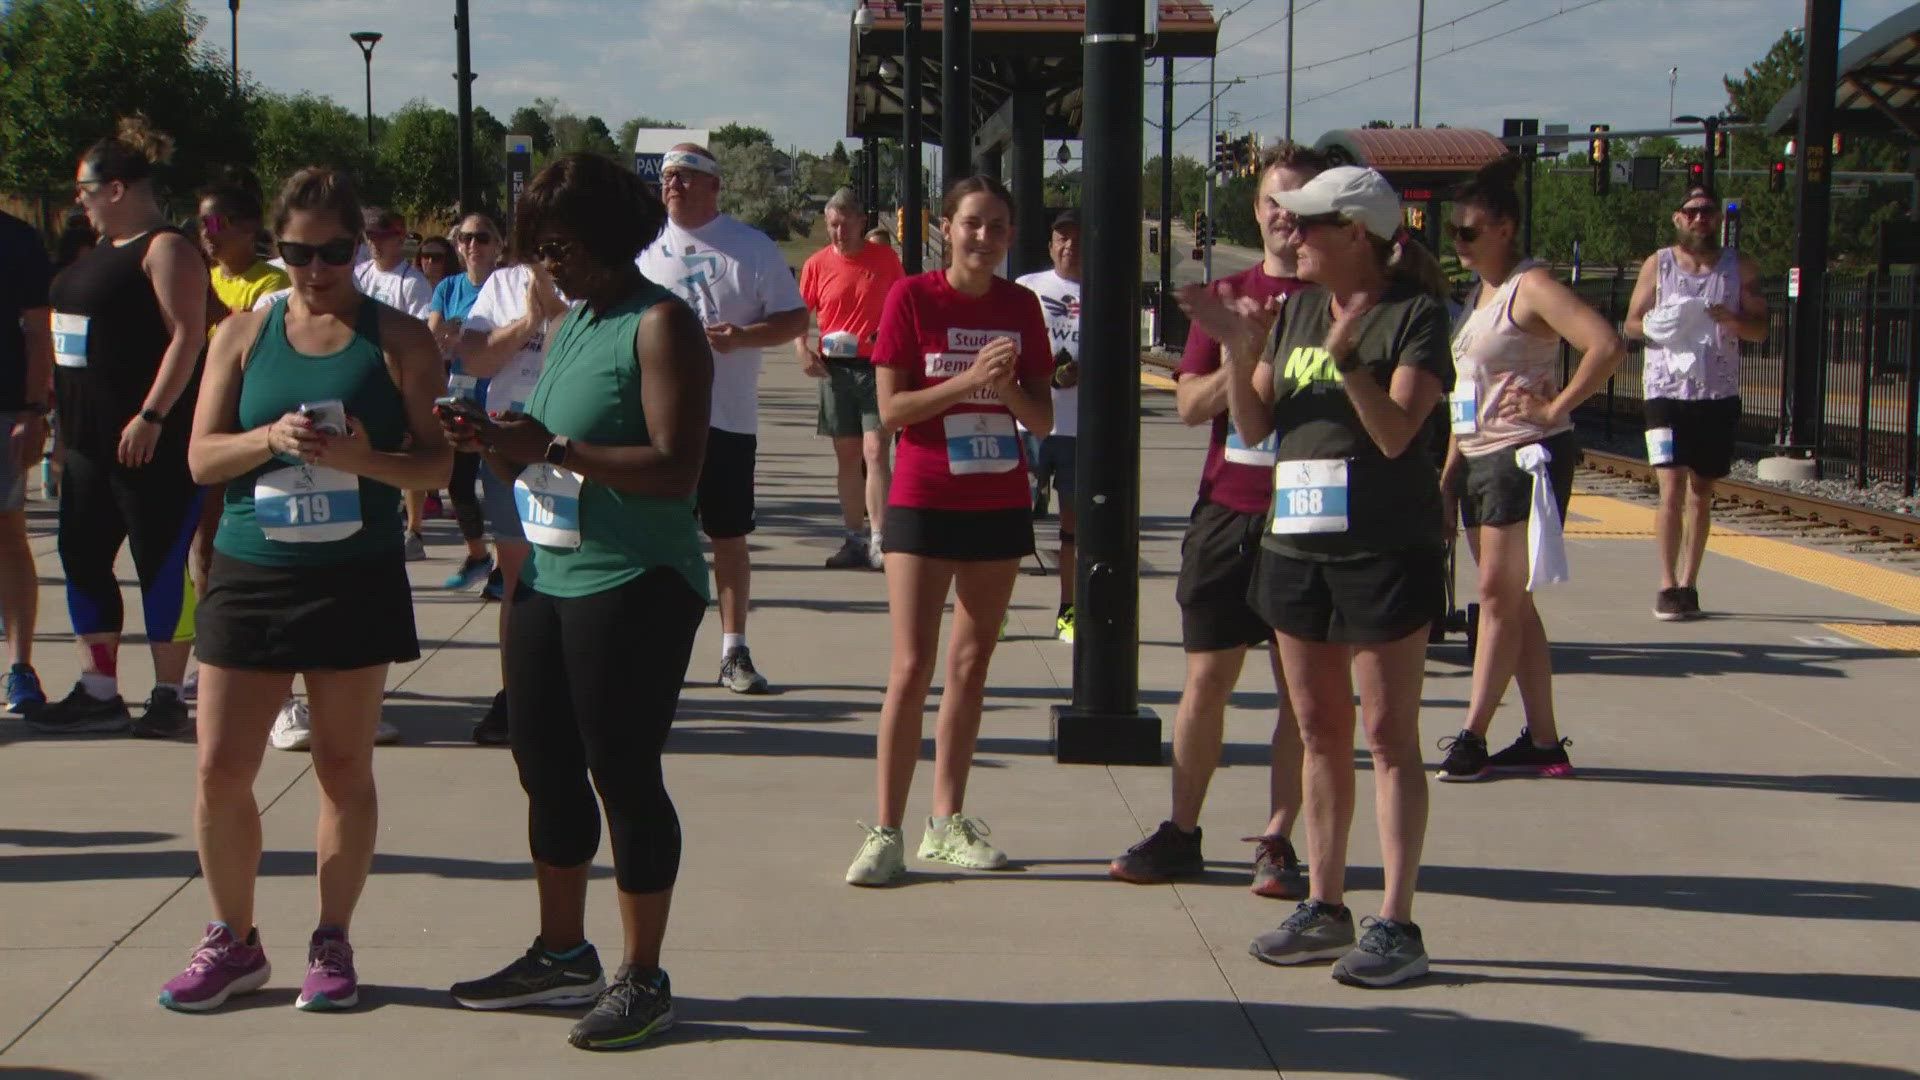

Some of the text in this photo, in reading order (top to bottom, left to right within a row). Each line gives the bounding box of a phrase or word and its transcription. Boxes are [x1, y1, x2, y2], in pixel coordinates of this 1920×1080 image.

[968, 435, 1000, 459] 176
[285, 493, 331, 524] 119
[527, 494, 555, 526] 118
[1286, 488, 1324, 516] 168
